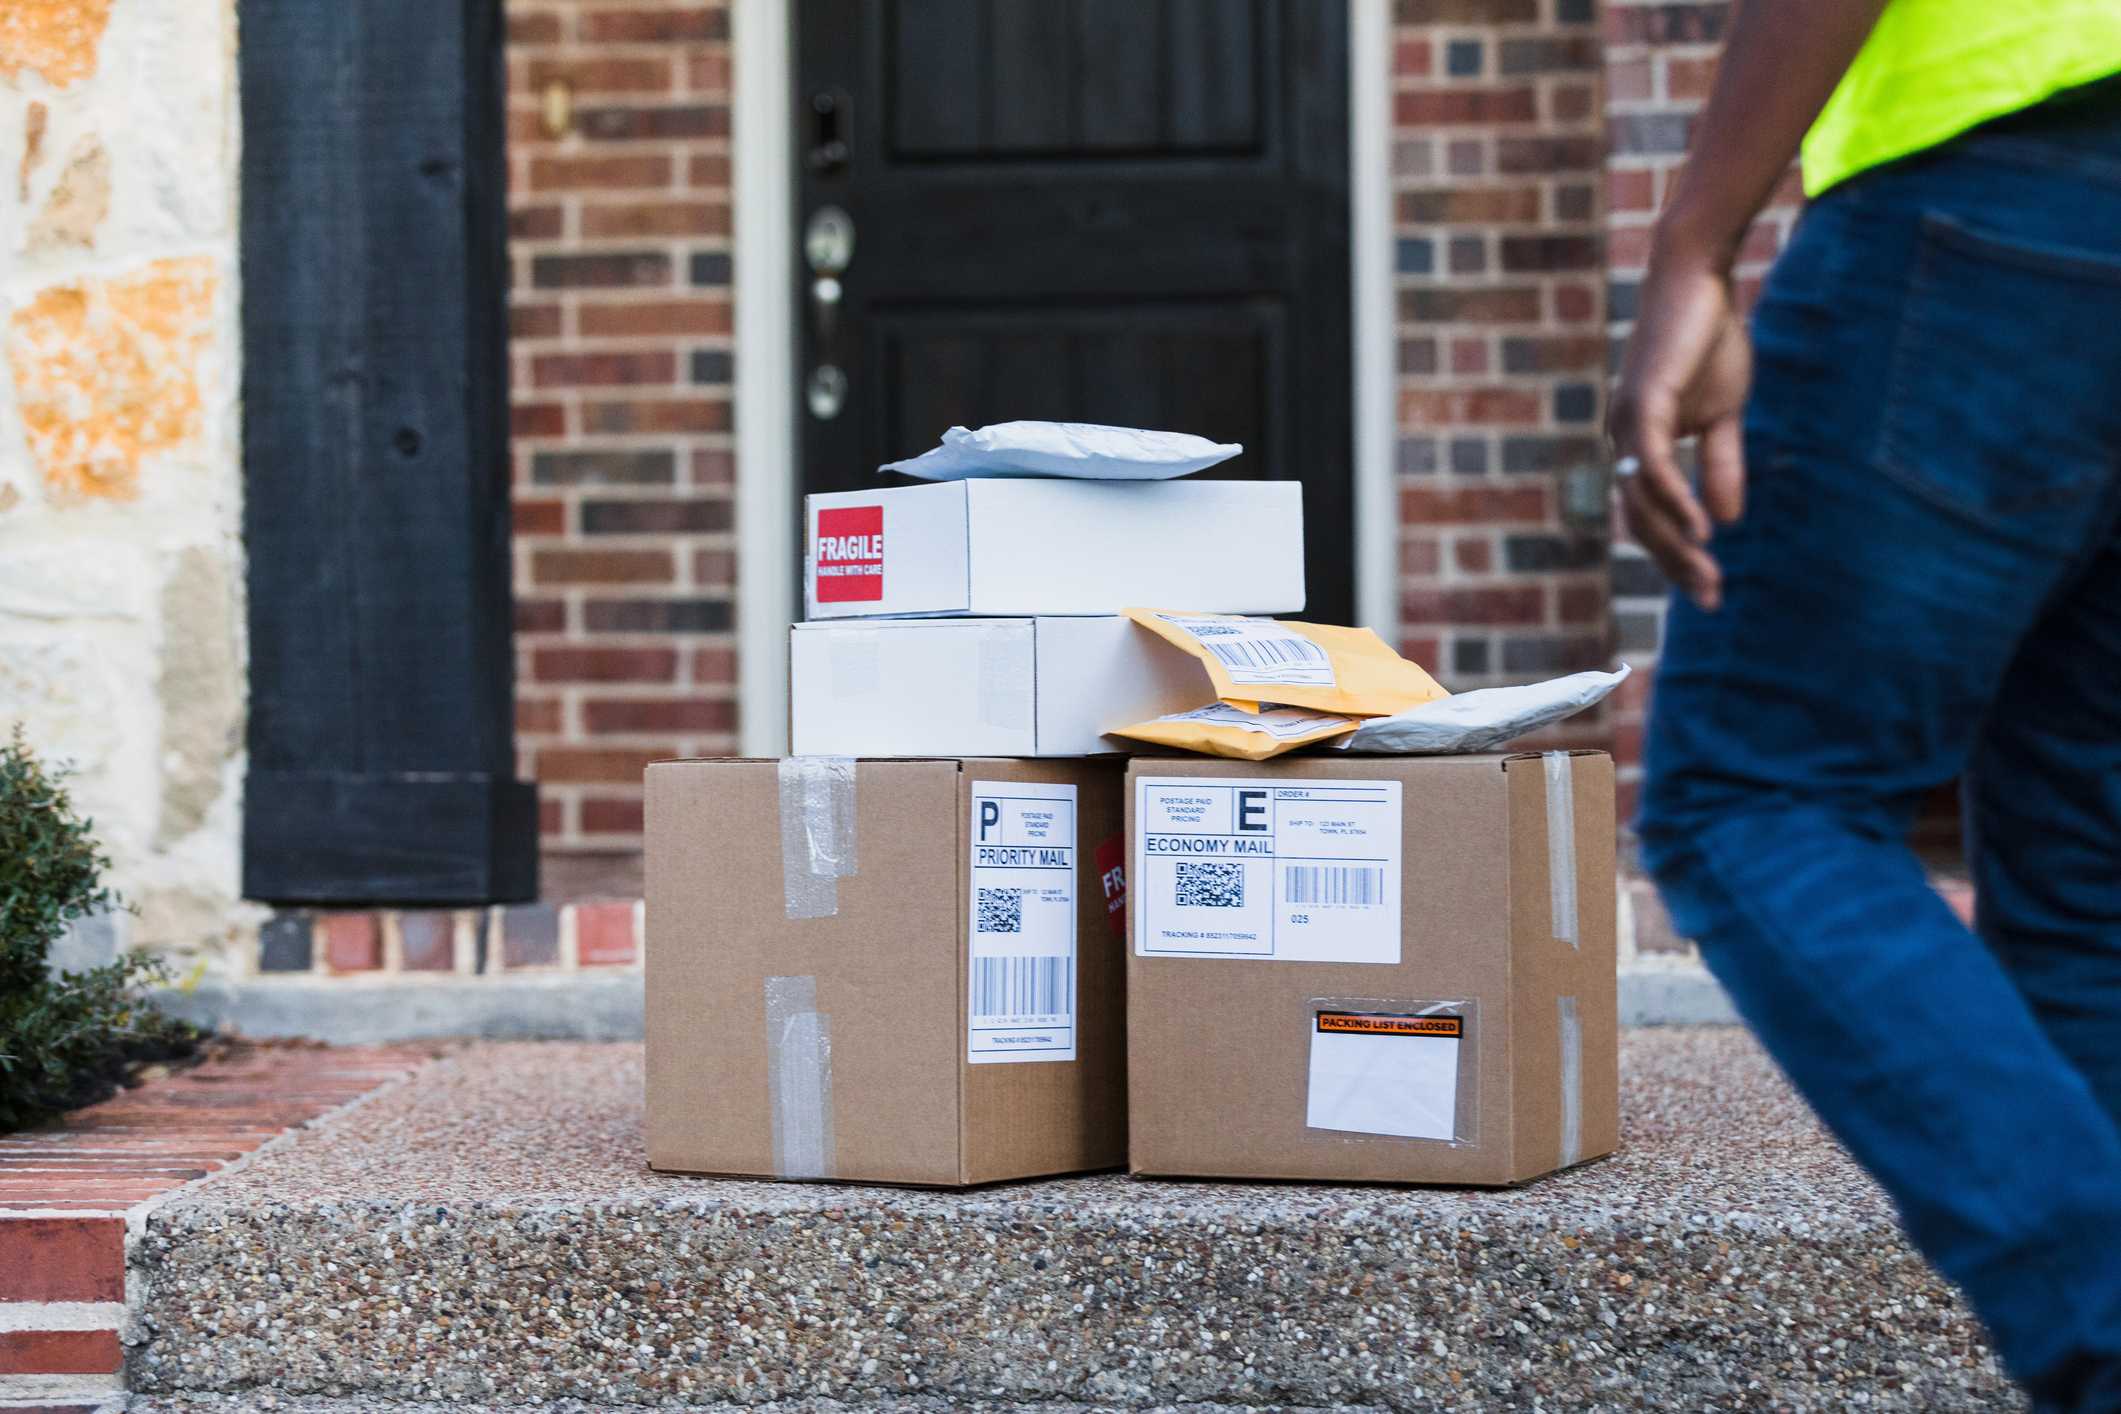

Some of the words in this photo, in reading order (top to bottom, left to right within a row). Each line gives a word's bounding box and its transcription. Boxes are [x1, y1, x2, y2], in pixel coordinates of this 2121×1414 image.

[817, 533, 883, 561] FRAGILE
[817, 565, 844, 577] HANDLE
[846, 565, 862, 576] WITH
[864, 564, 883, 576] CARE
[1278, 790, 1304, 798] ORDER
[1160, 797, 1194, 806] POSTAGE
[1196, 798, 1212, 806] PAID
[1167, 806, 1206, 814] STANDARD
[1239, 791, 1267, 831] E
[981, 801, 999, 841] P
[1171, 815, 1201, 823] PRICING
[1147, 838, 1229, 853] ECONOMY
[1234, 840, 1273, 854] MAIL
[979, 848, 1037, 865] PRIORITY
[1040, 849, 1069, 866] MAIL
[1290, 913, 1310, 924] 025
[1161, 930, 1199, 939] TRACKING
[1322, 1017, 1371, 1029] PACKING
[1374, 1019, 1395, 1030] LIST
[1397, 1020, 1457, 1032] ENCLOSED
